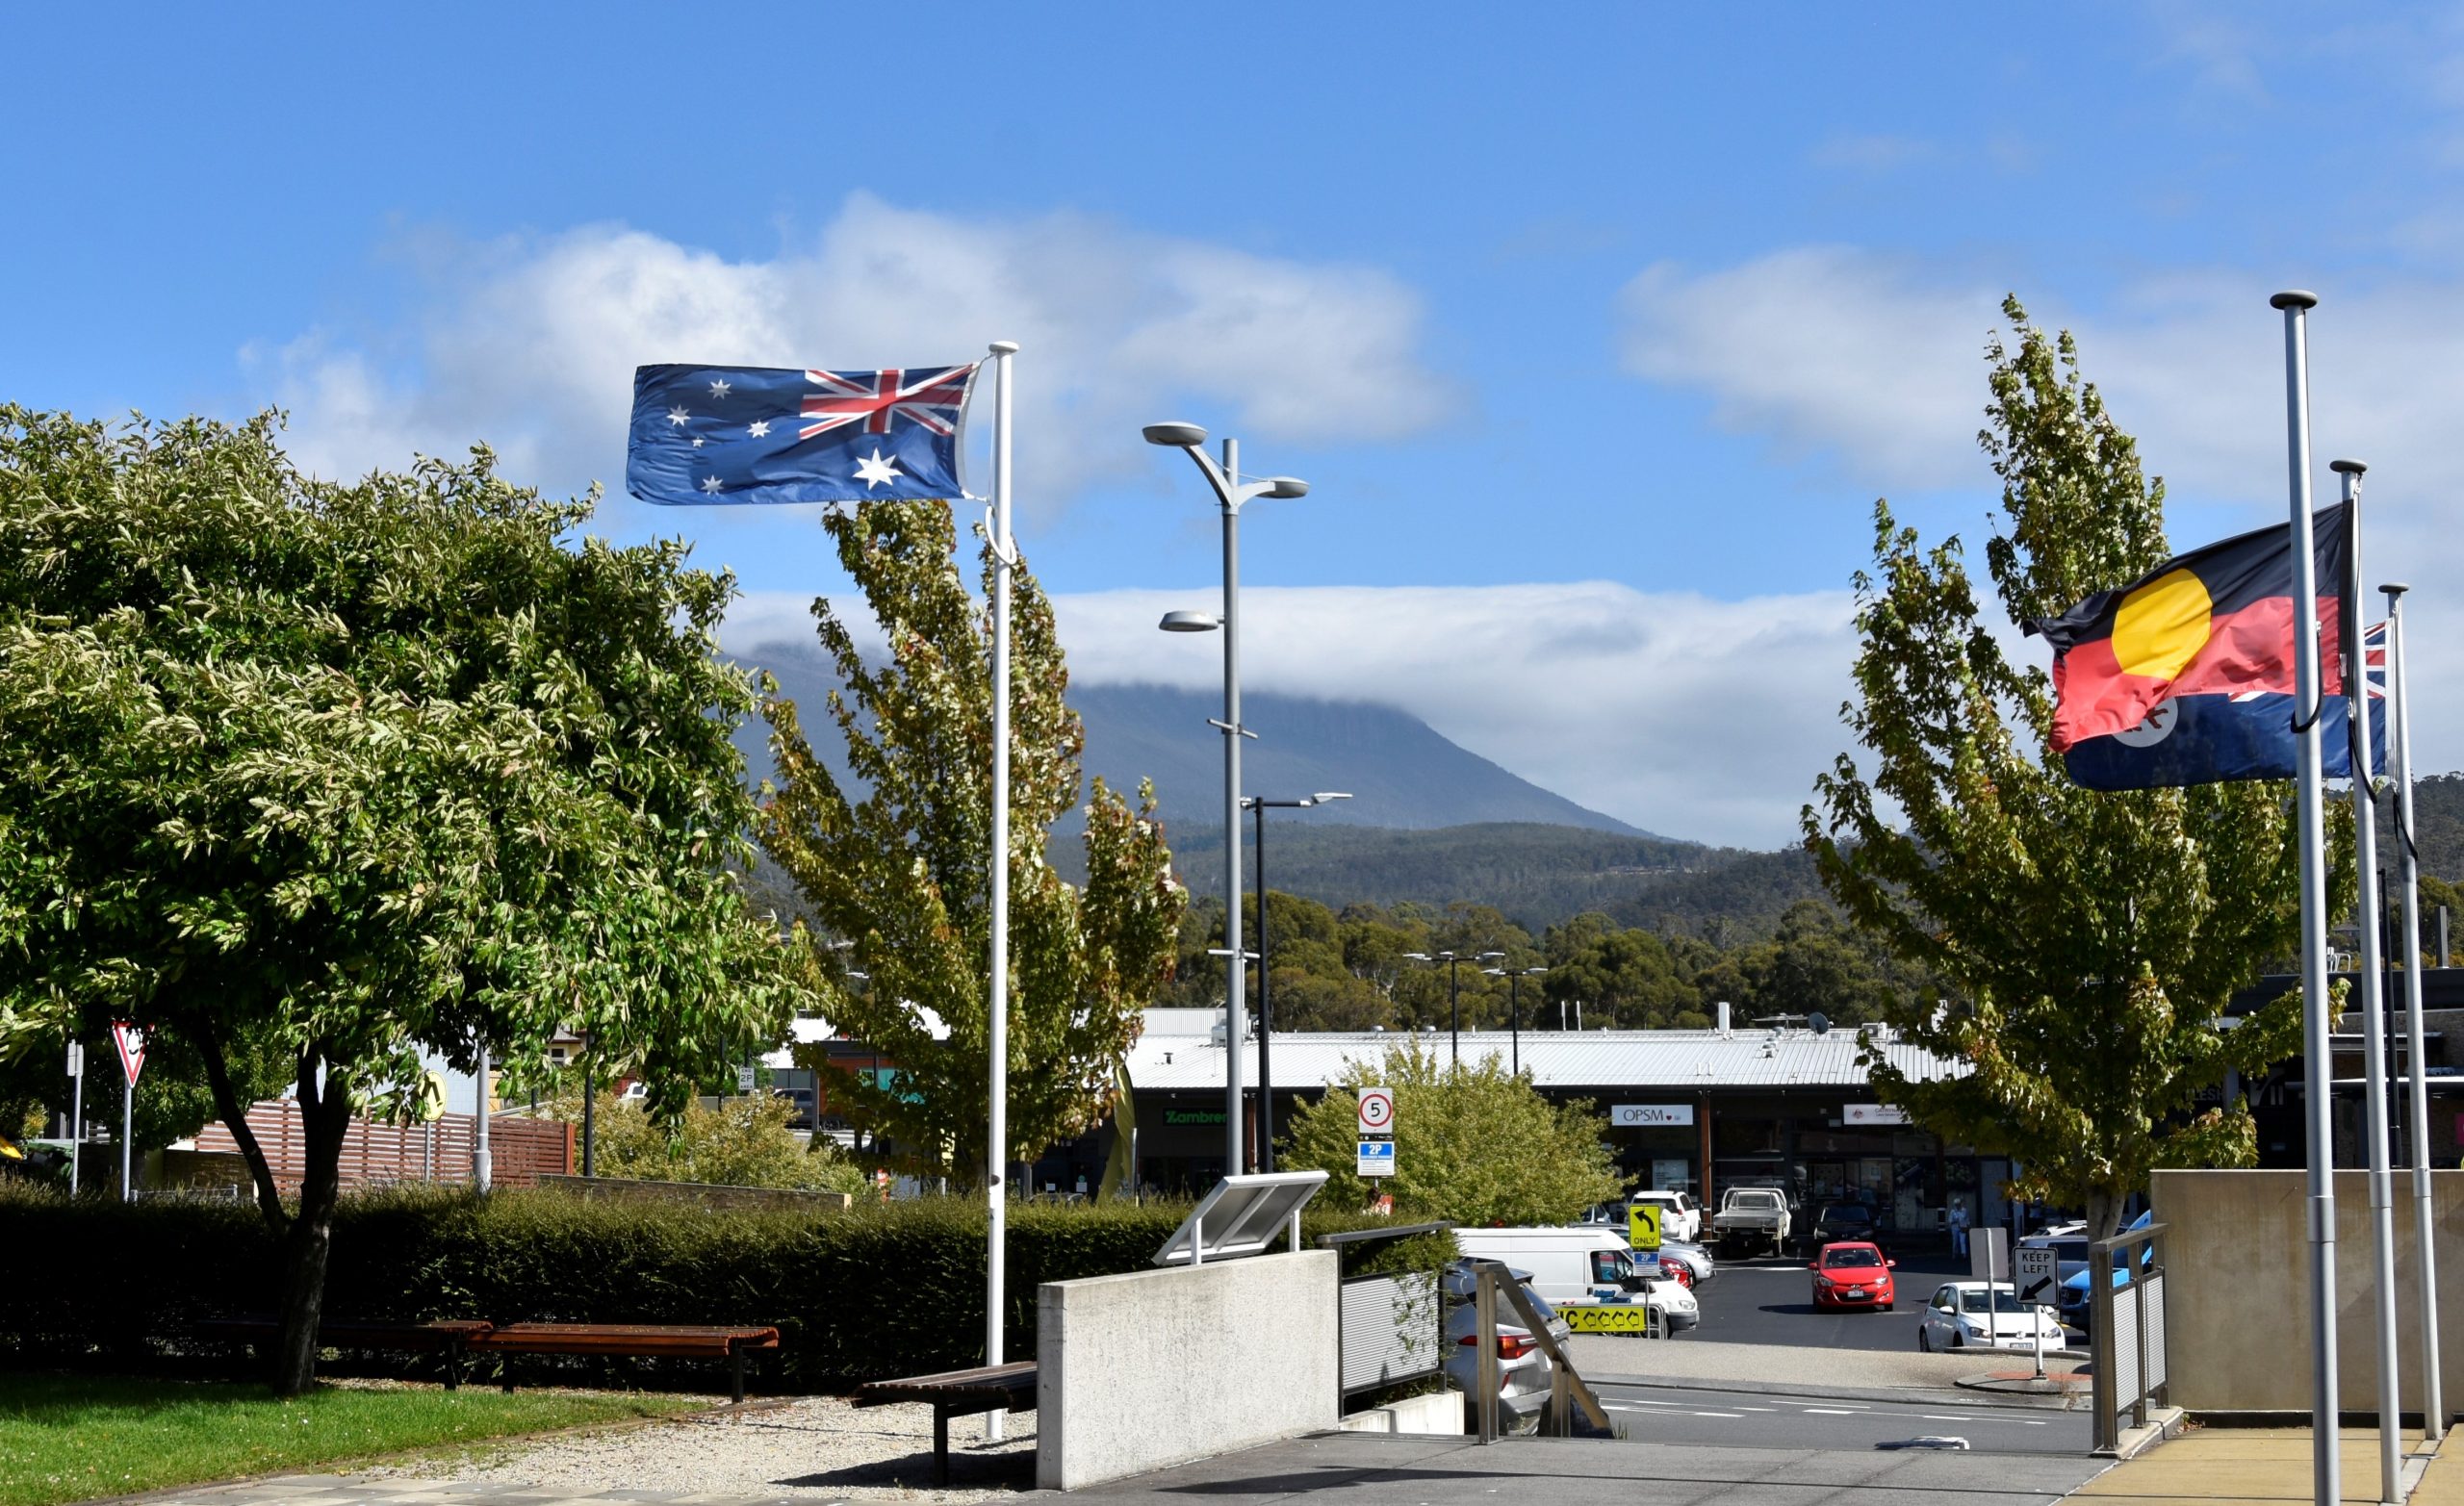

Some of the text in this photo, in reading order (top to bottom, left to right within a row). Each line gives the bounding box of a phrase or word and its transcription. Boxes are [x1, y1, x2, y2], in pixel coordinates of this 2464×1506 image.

[740, 1074, 753, 1083] 2P
[1371, 1102, 1381, 1117] 5
[1623, 1109, 1664, 1122] OPSM
[1369, 1144, 1382, 1156] 2P
[1633, 1237, 1656, 1245] ONLY
[2021, 1253, 2050, 1262] KEEP
[2023, 1264, 2049, 1274] LEFT
